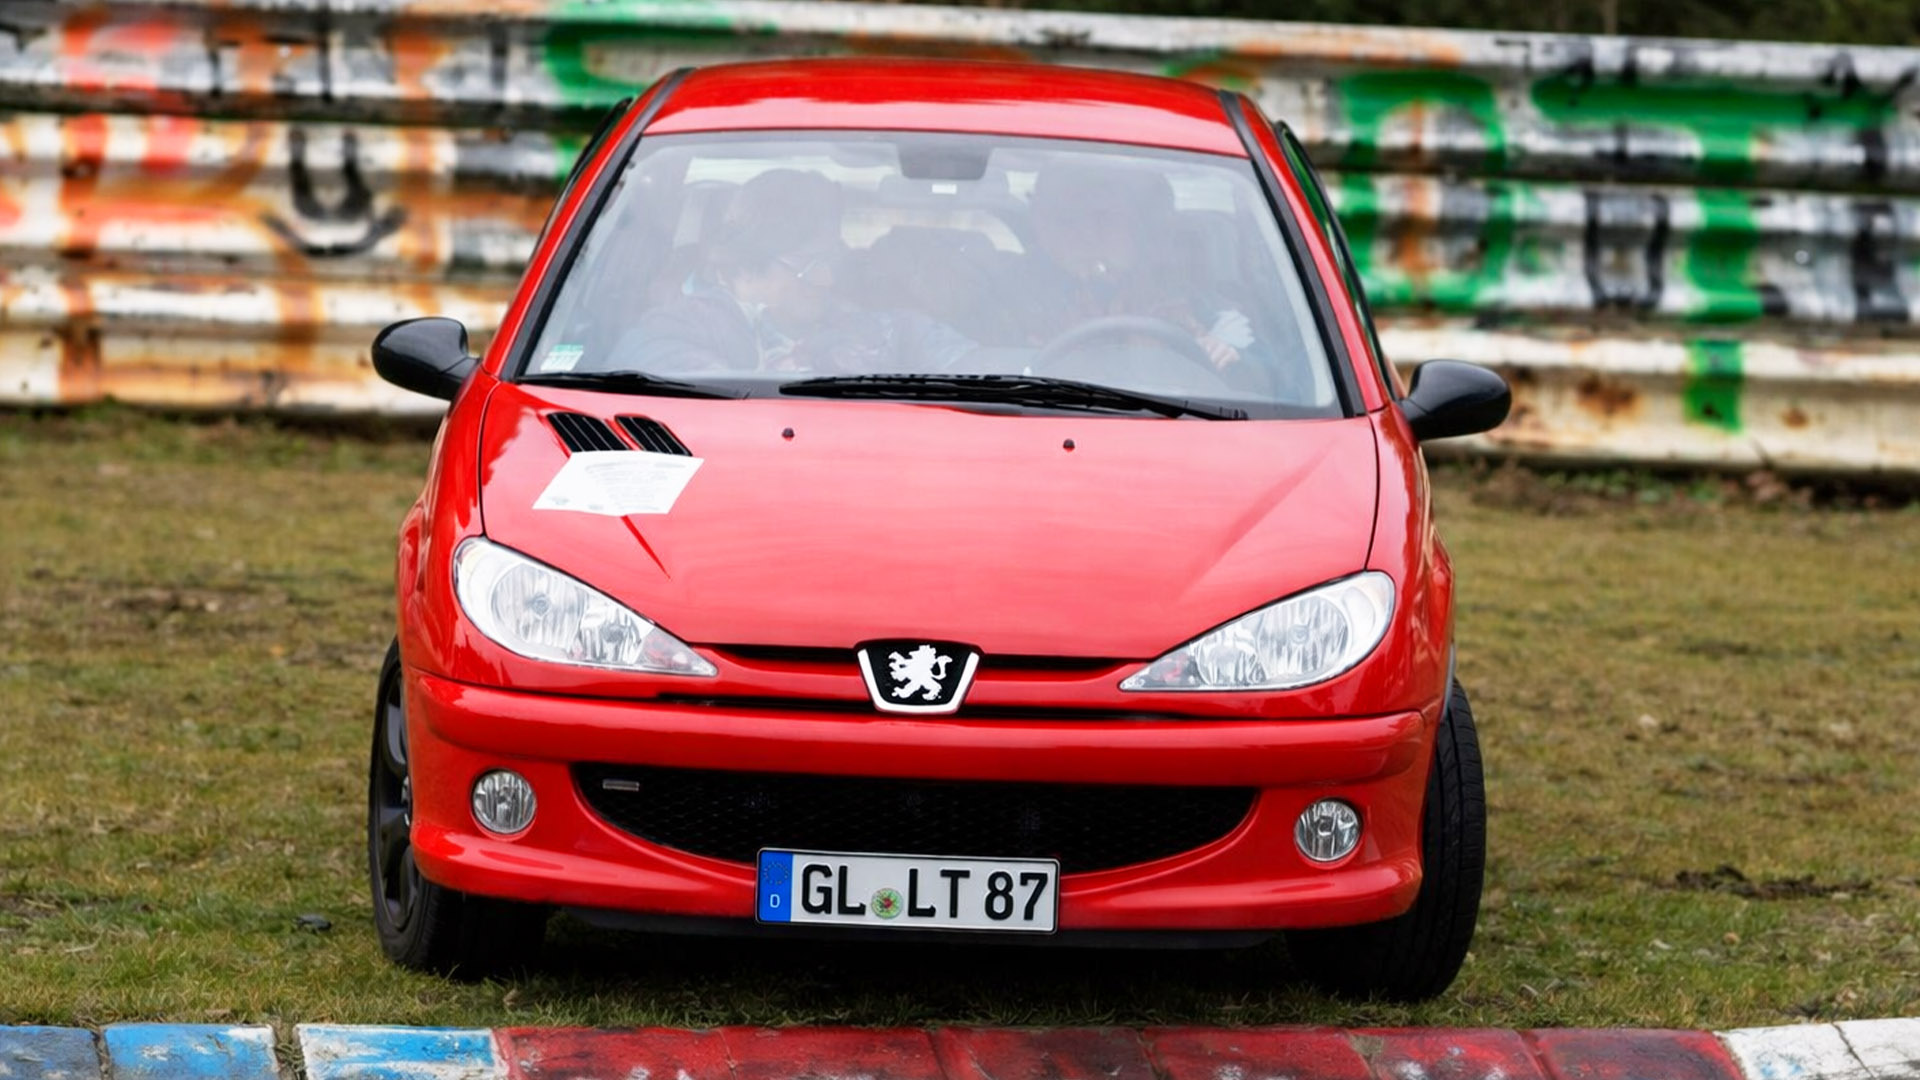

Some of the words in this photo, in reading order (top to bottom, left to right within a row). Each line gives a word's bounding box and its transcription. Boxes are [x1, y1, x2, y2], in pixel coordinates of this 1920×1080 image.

[769, 893, 781, 908] D
[801, 864, 867, 916] GL
[907, 868, 971, 919] LT
[984, 871, 1049, 921] 87
